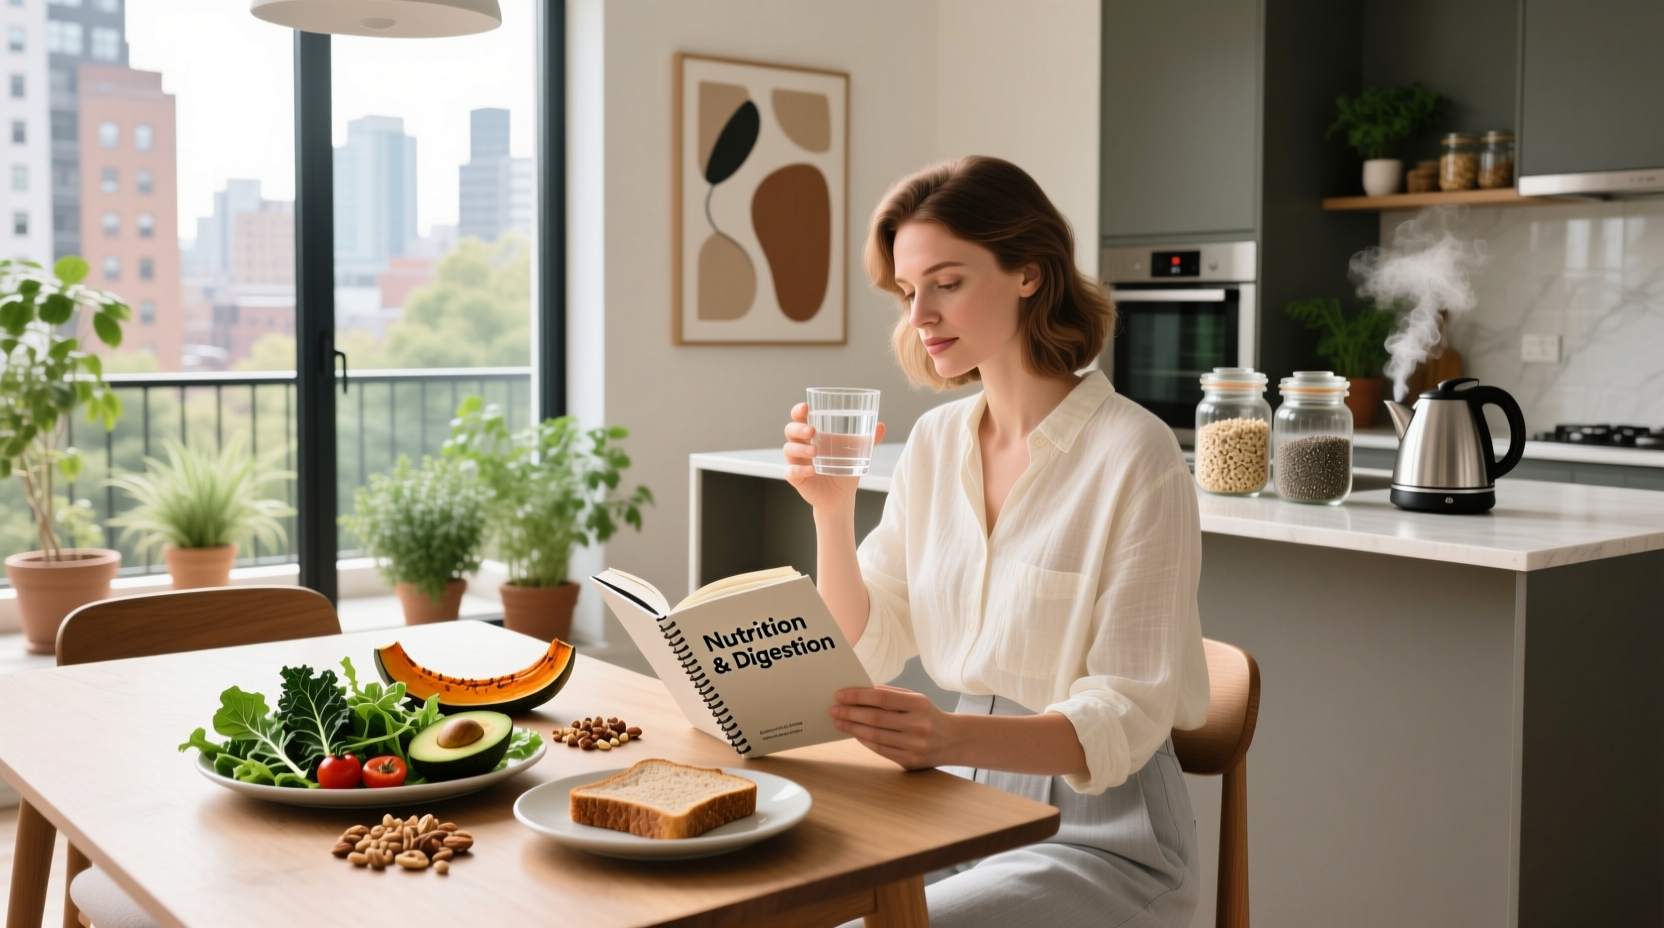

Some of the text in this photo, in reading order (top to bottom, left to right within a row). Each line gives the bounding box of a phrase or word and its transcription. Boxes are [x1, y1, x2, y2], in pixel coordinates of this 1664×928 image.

[702, 616, 807, 652] Nutrition
[713, 636, 835, 674] & Digestion
